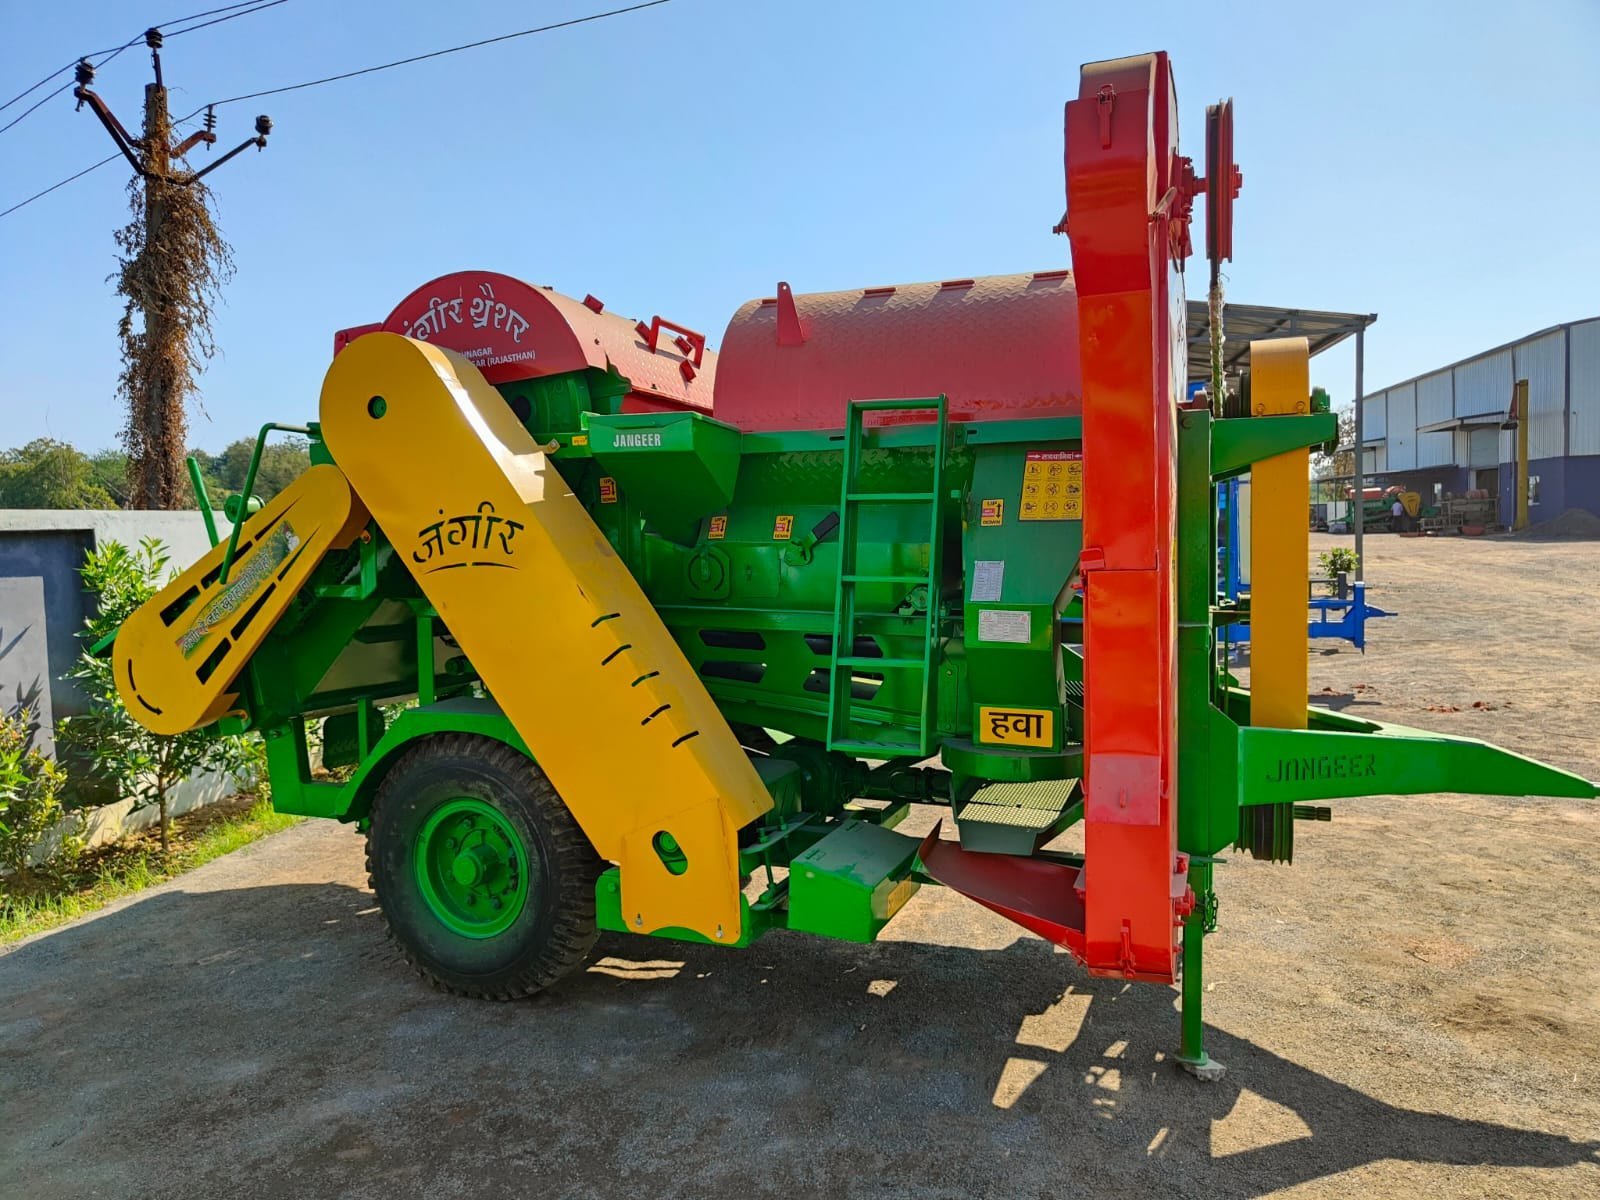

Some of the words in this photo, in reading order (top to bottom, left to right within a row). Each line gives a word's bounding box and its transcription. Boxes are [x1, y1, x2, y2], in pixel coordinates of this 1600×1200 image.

[487, 350, 536, 367] (RAJASTHAN)
[613, 433, 662, 448] JANGEER
[413, 501, 525, 563] जंगीर
[988, 712, 1044, 739] हवा
[1265, 754, 1377, 783] JANGEER
